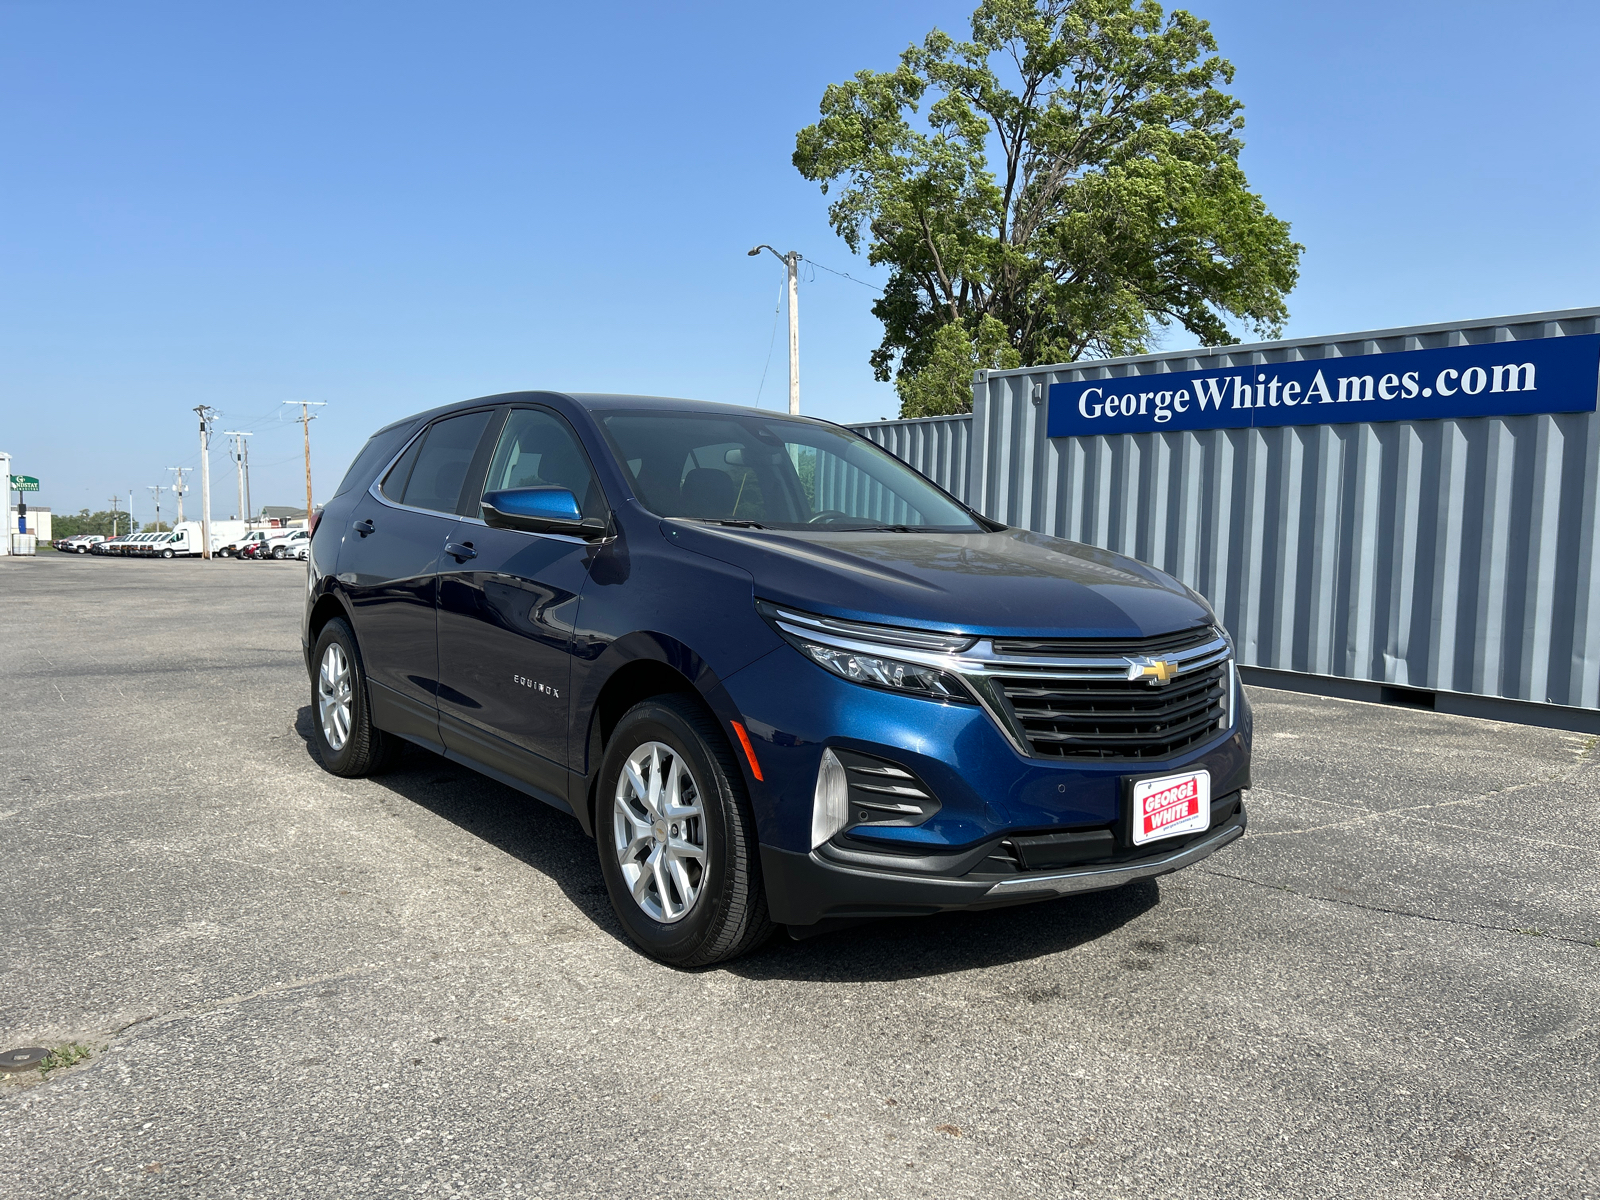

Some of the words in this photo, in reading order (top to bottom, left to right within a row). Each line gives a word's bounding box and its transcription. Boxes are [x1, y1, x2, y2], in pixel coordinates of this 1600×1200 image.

[1078, 361, 1537, 423] GeorgeWhiteAmes.com
[513, 674, 559, 699] EQUINOX
[1145, 781, 1194, 813] GEORGE
[1150, 801, 1189, 829] WHITE
